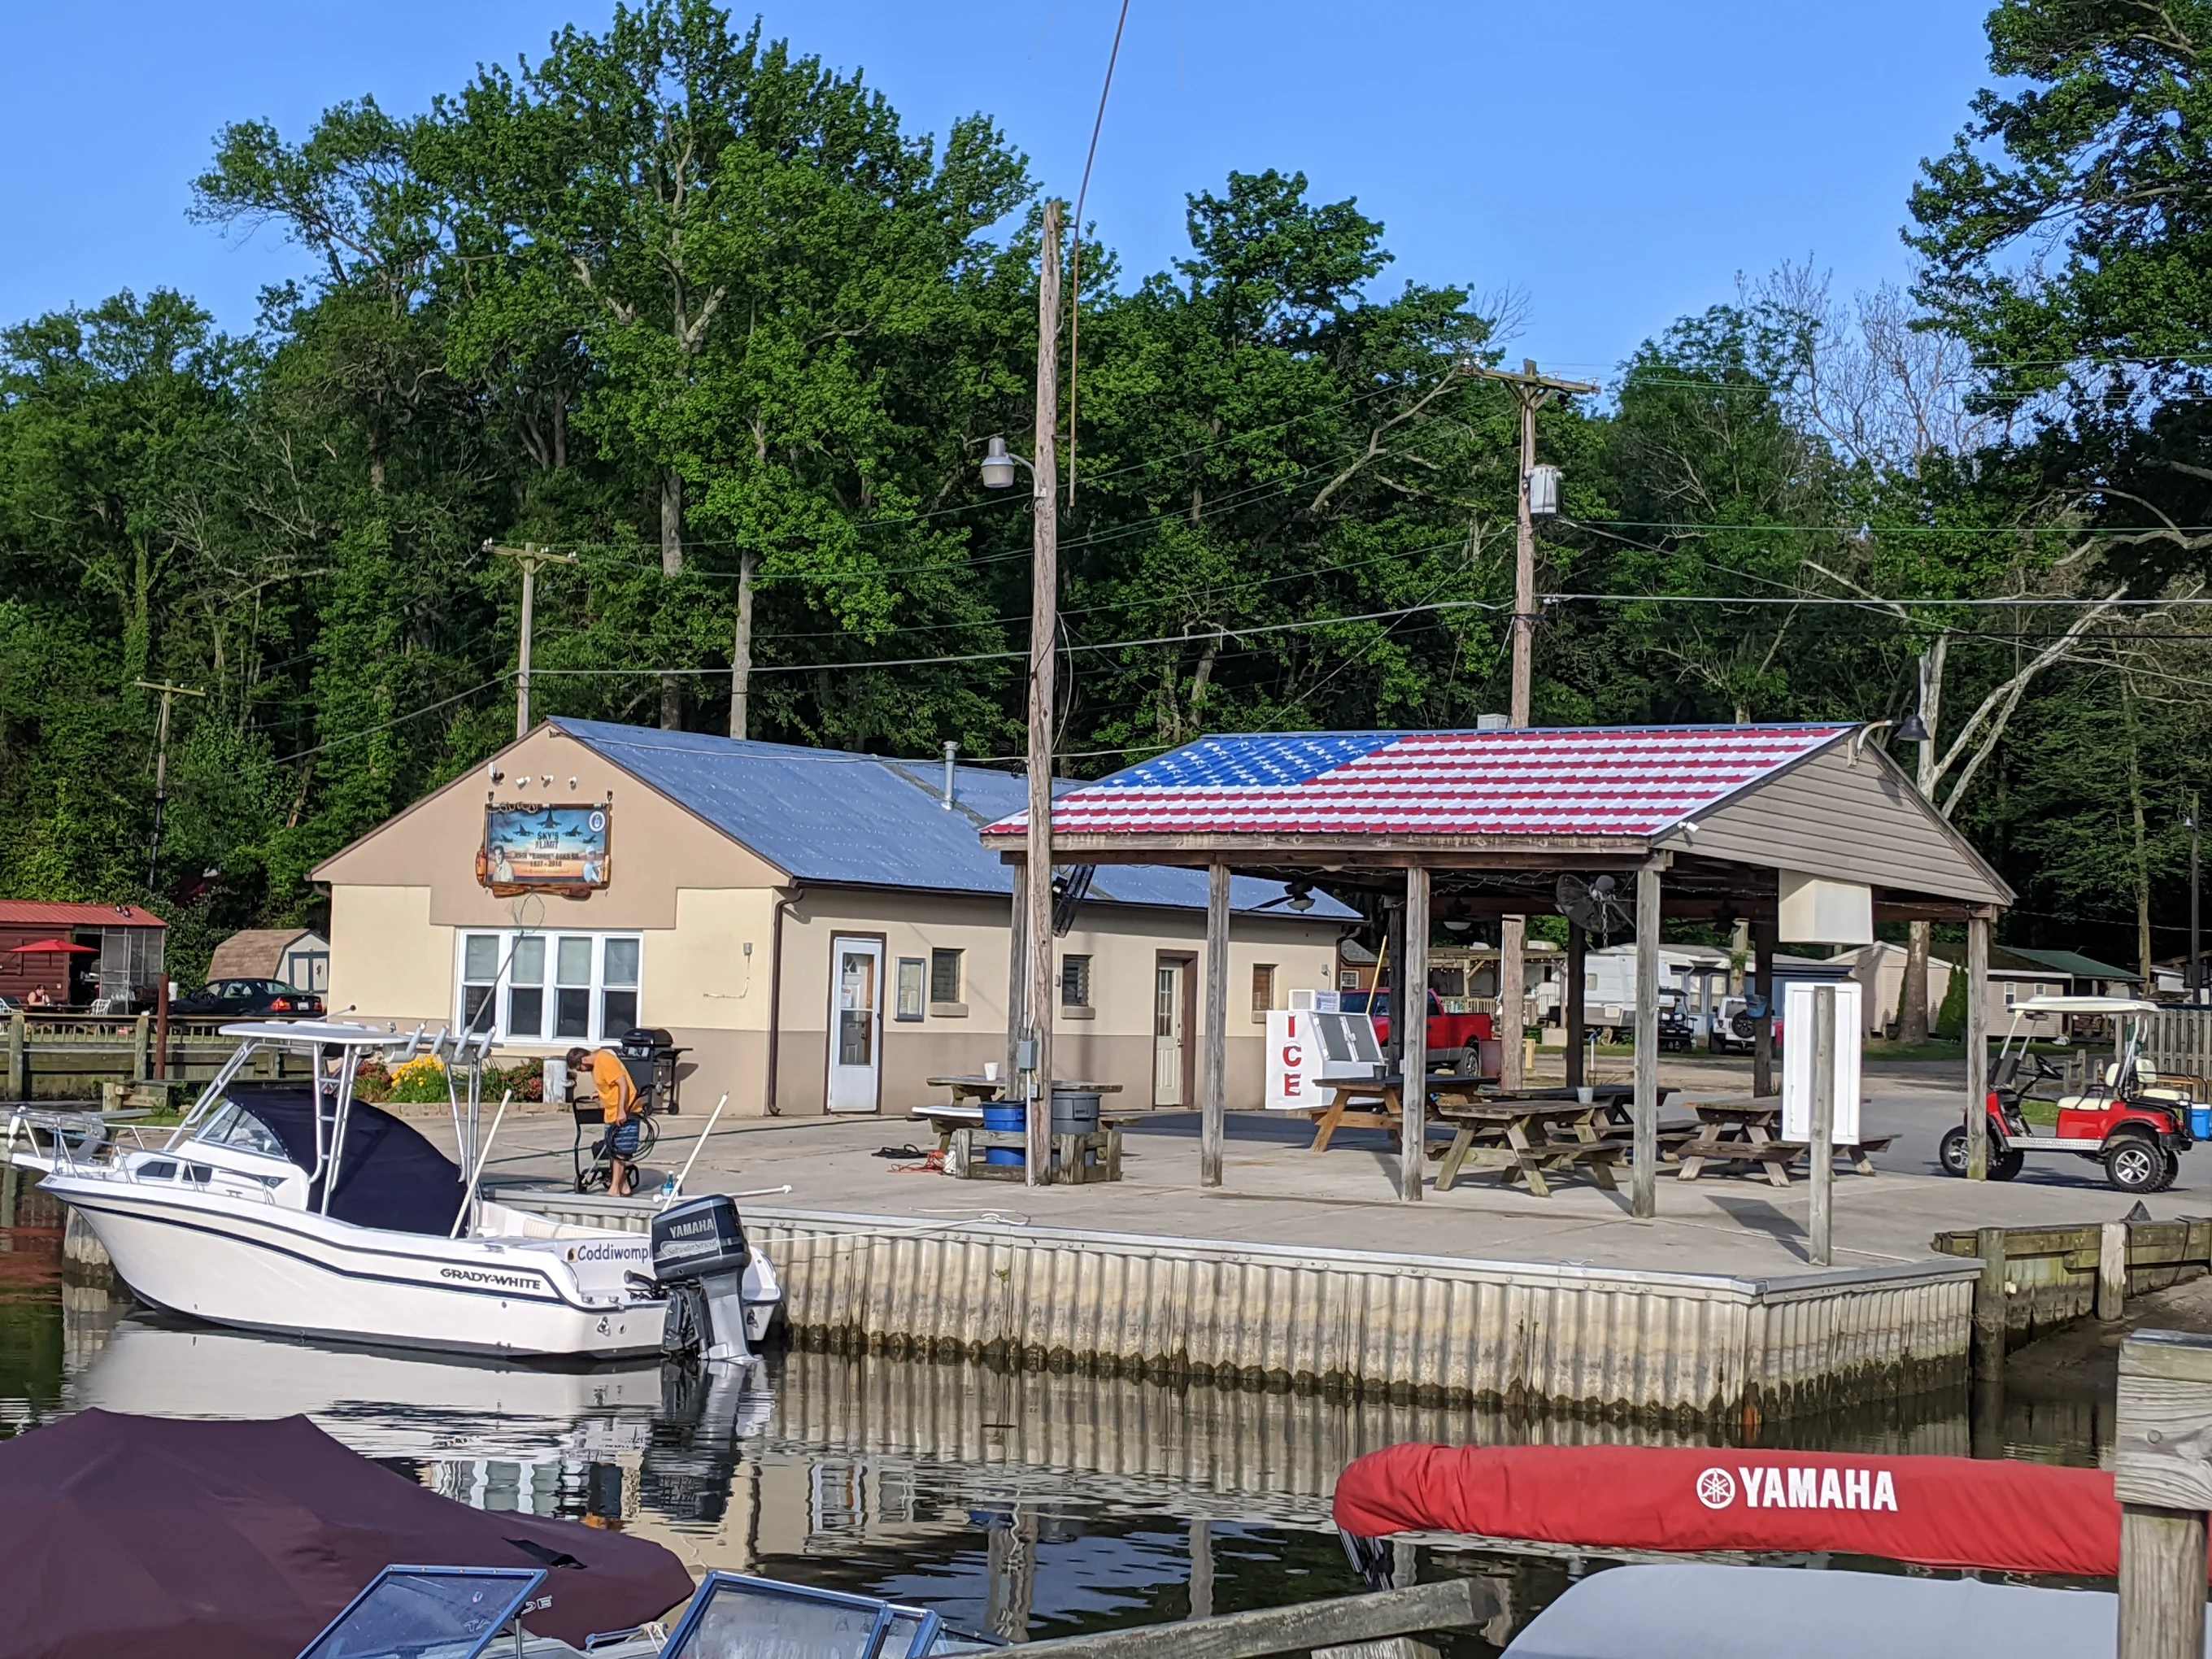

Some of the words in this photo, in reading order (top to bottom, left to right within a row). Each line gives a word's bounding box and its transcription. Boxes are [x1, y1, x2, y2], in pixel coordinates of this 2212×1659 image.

[1282, 1015, 1302, 1096] ICE
[669, 1218, 714, 1239] YAMAHA
[440, 1268, 541, 1290] GRADY-WHITE
[1738, 1466, 1899, 1512] YAMAHA
